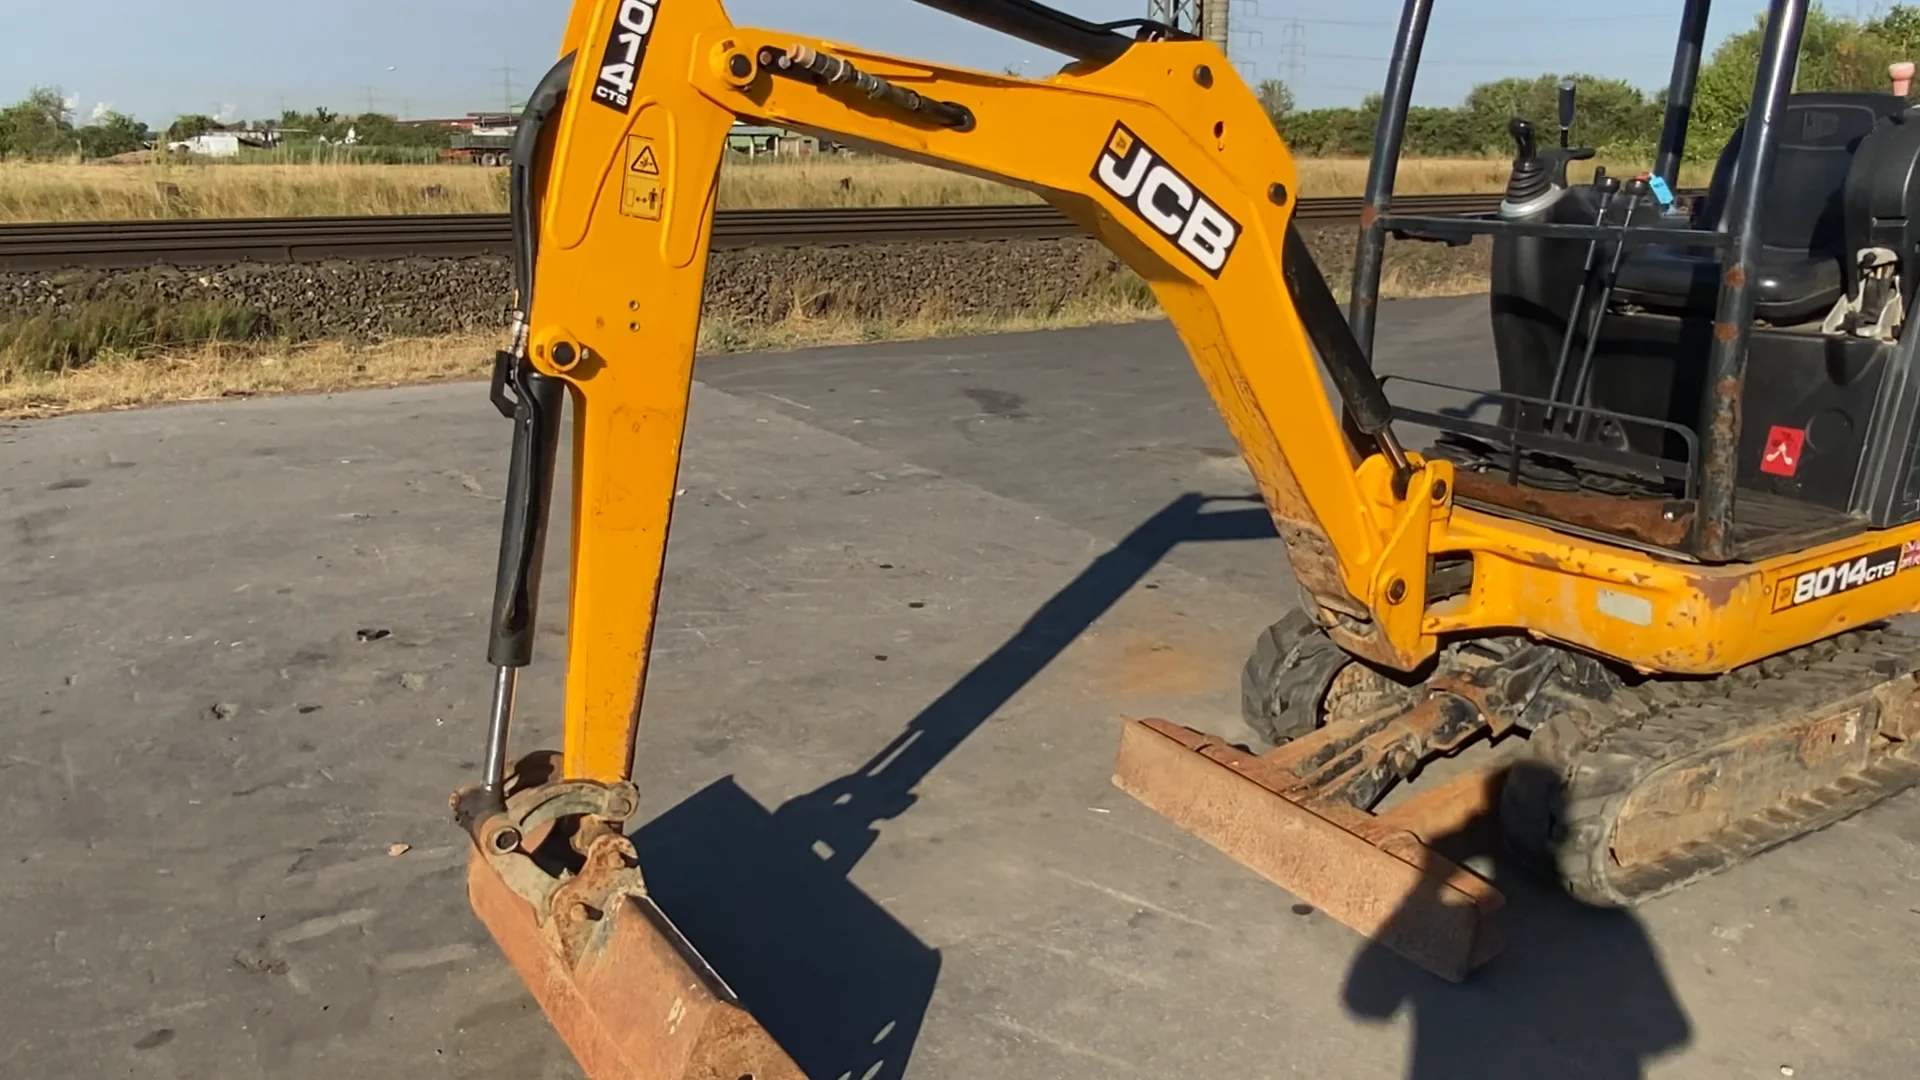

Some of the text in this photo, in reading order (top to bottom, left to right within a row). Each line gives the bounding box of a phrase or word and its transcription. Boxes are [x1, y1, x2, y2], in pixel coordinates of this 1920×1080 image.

[596, 0, 658, 107] 014 CTS
[1098, 147, 1235, 270] JCB
[1793, 556, 1896, 605] 8014 CTS
